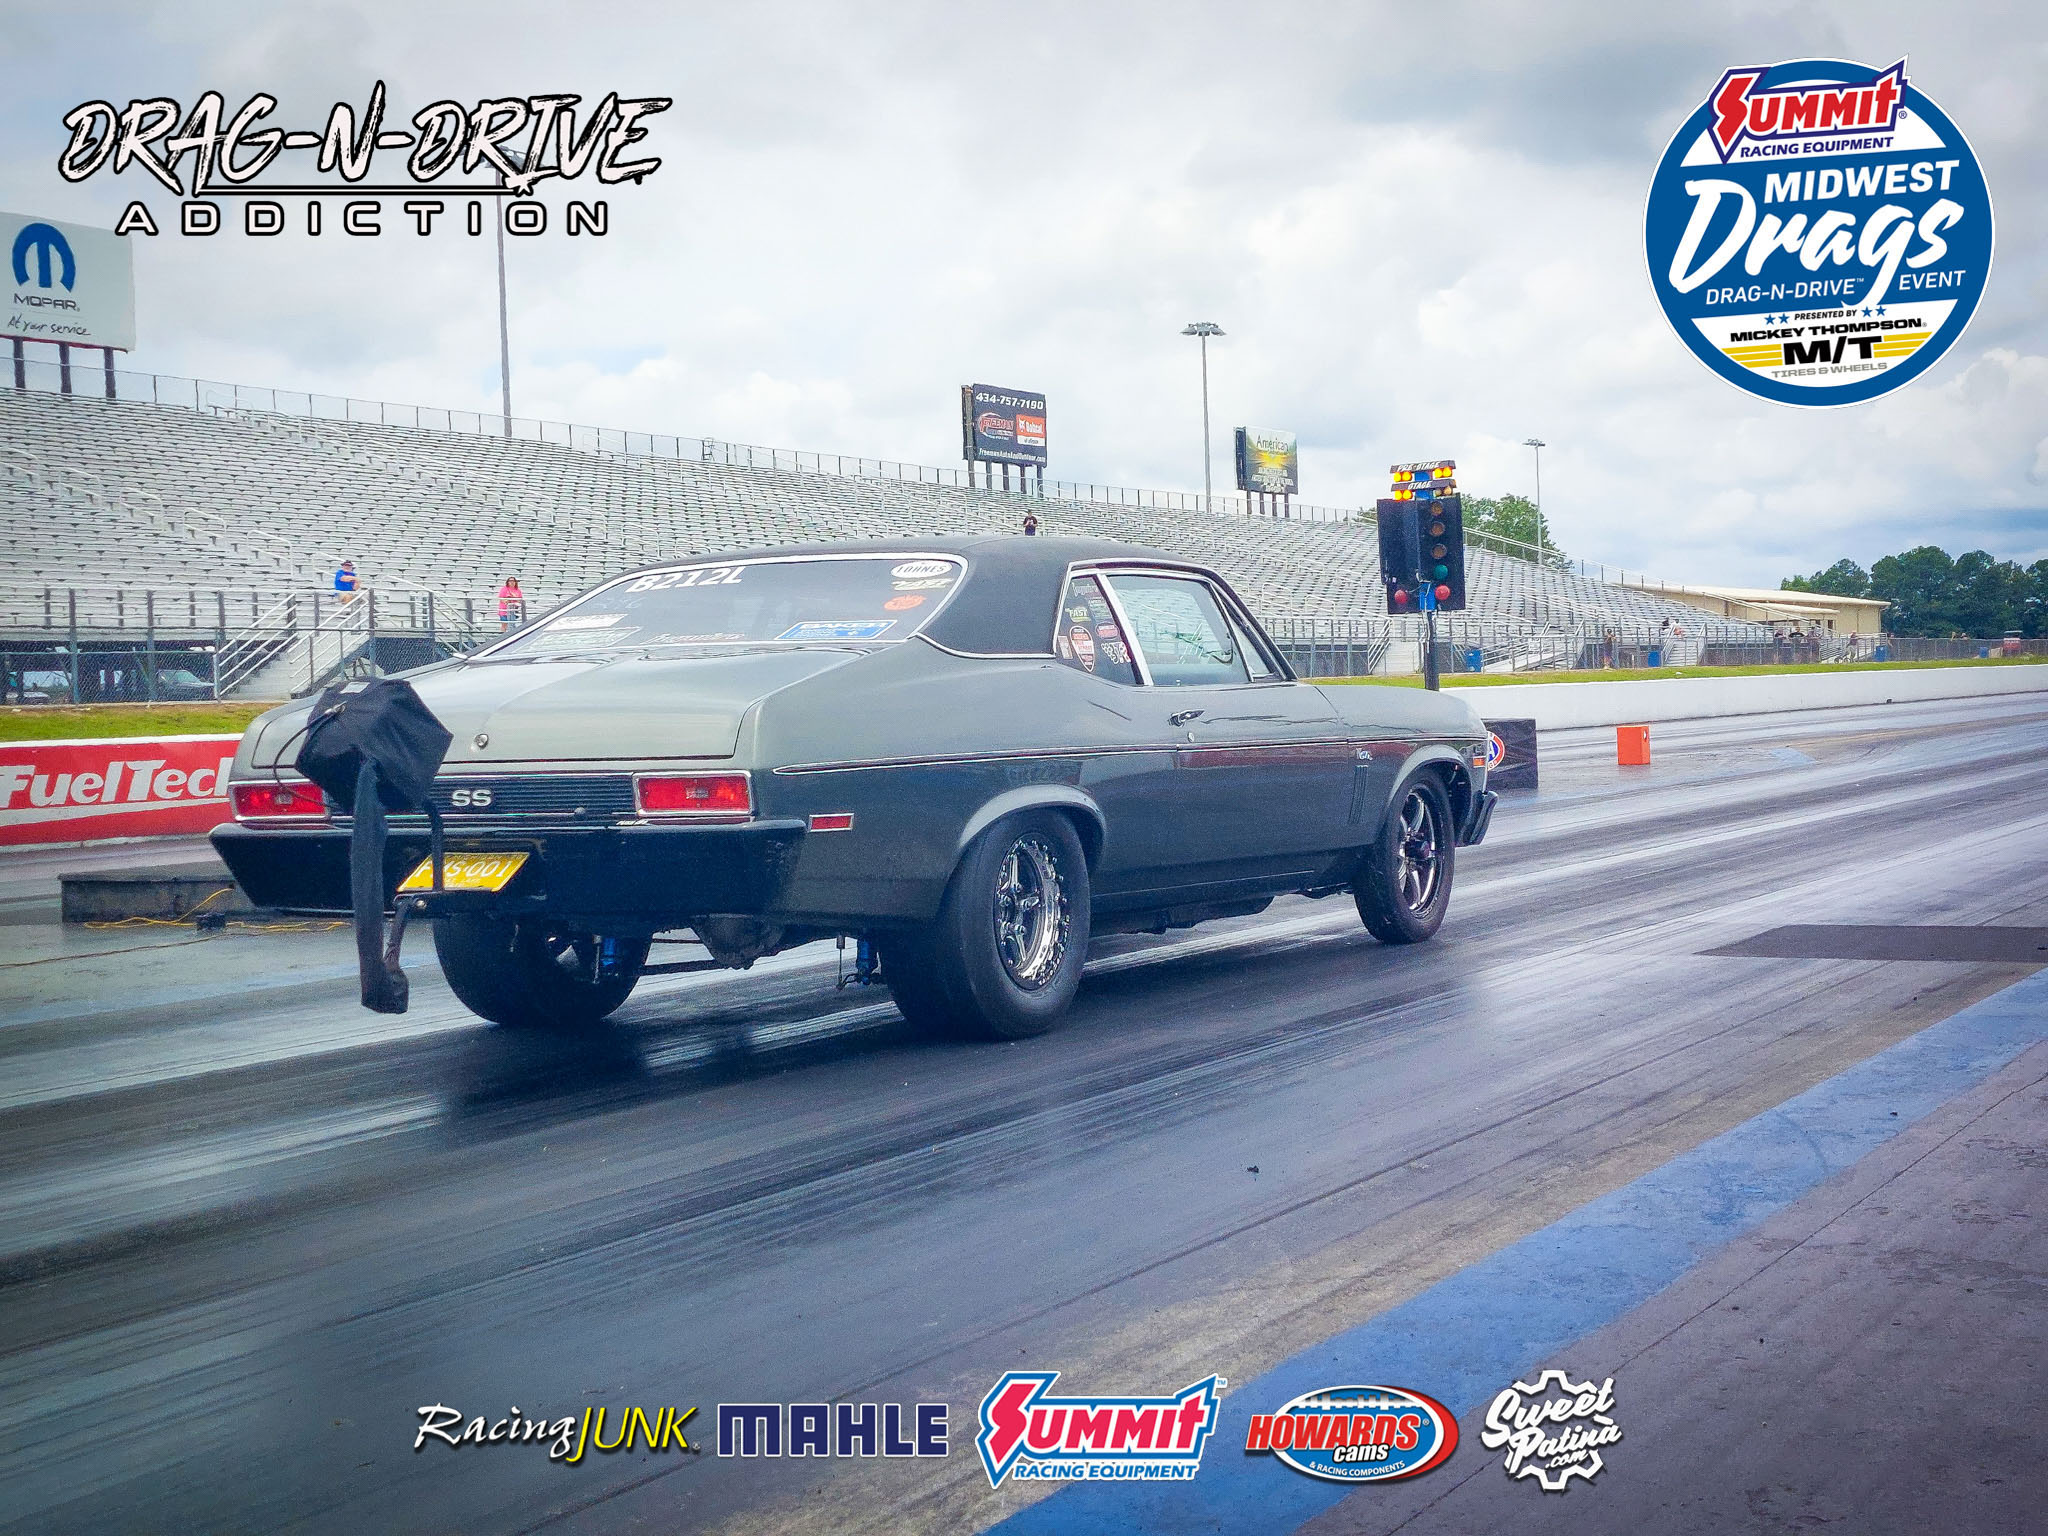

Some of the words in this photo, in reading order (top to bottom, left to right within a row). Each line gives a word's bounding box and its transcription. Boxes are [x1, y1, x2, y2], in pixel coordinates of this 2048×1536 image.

[13, 293, 77, 311] MOPAR
[51, 322, 91, 335] service
[975, 392, 1044, 410] 434-757-7190
[625, 566, 746, 593] B212L
[451, 789, 492, 807] SS
